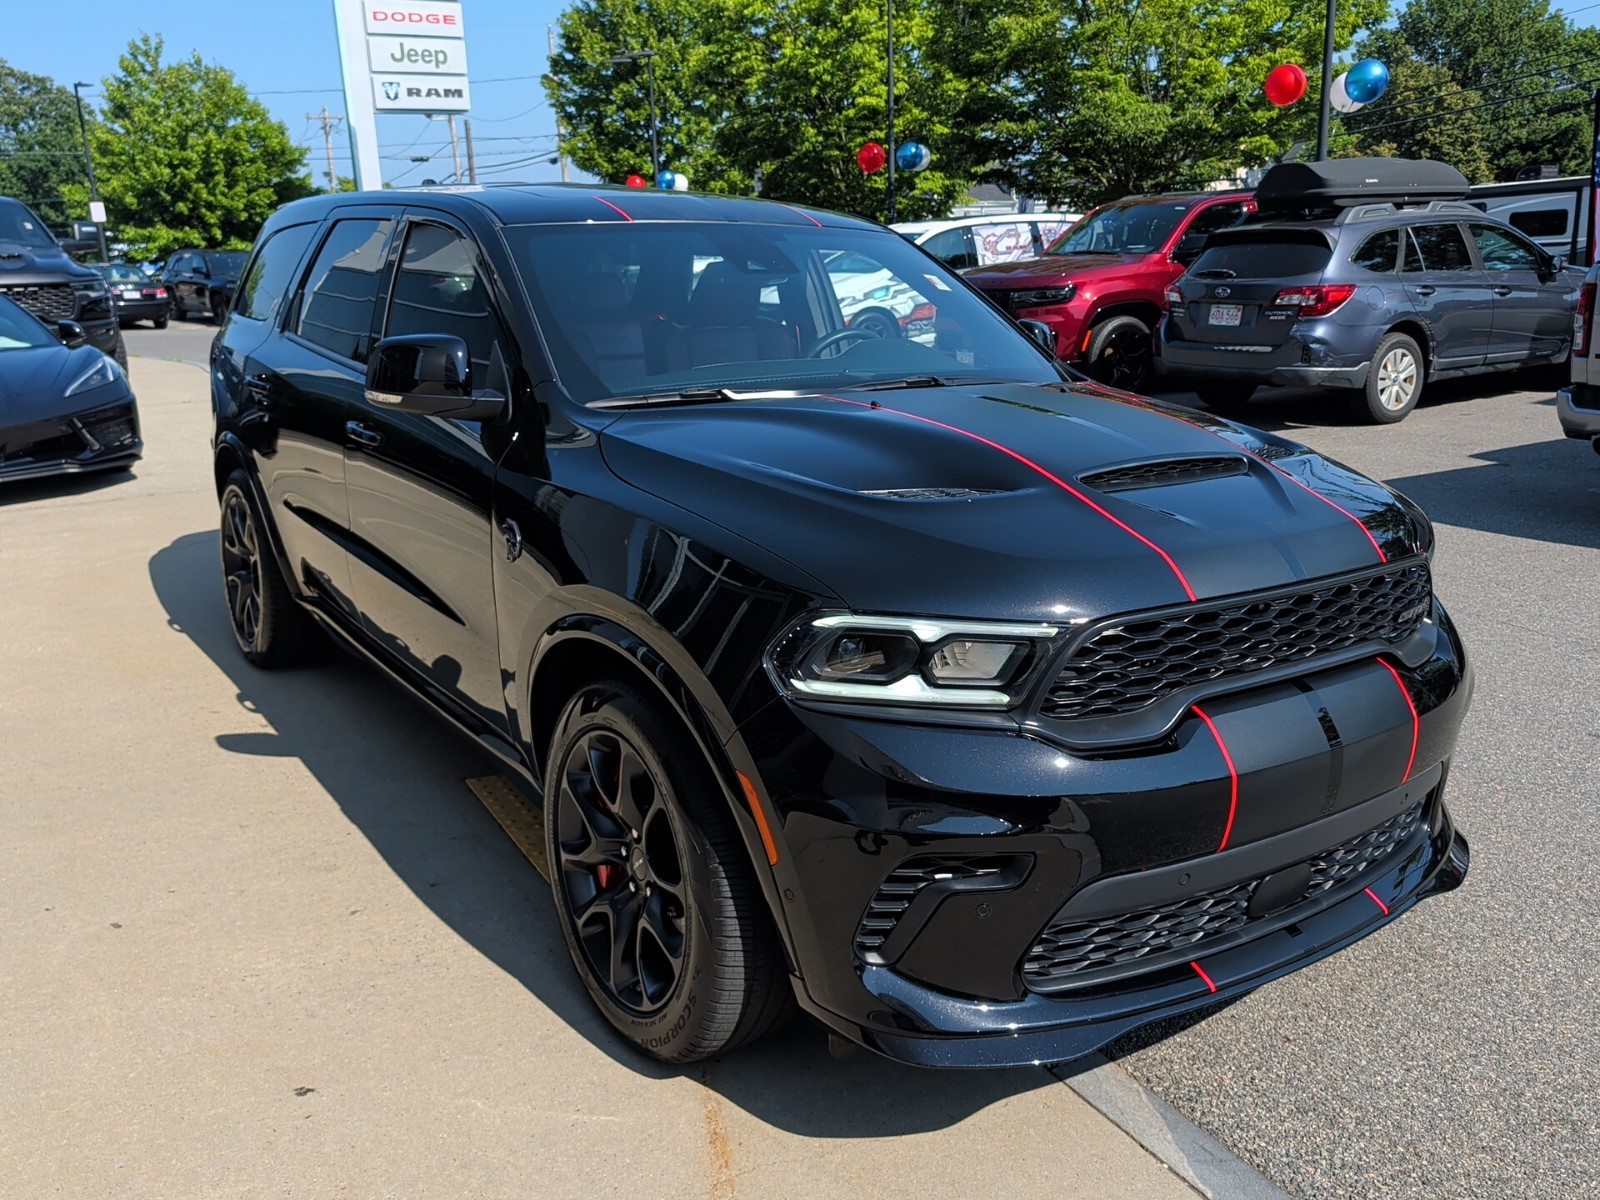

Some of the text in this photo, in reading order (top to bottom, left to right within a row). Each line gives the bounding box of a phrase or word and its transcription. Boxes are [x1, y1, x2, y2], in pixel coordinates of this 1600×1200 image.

[372, 11, 457, 25] DODGE
[390, 42, 448, 69] Jeep
[406, 87, 464, 99] RAM
